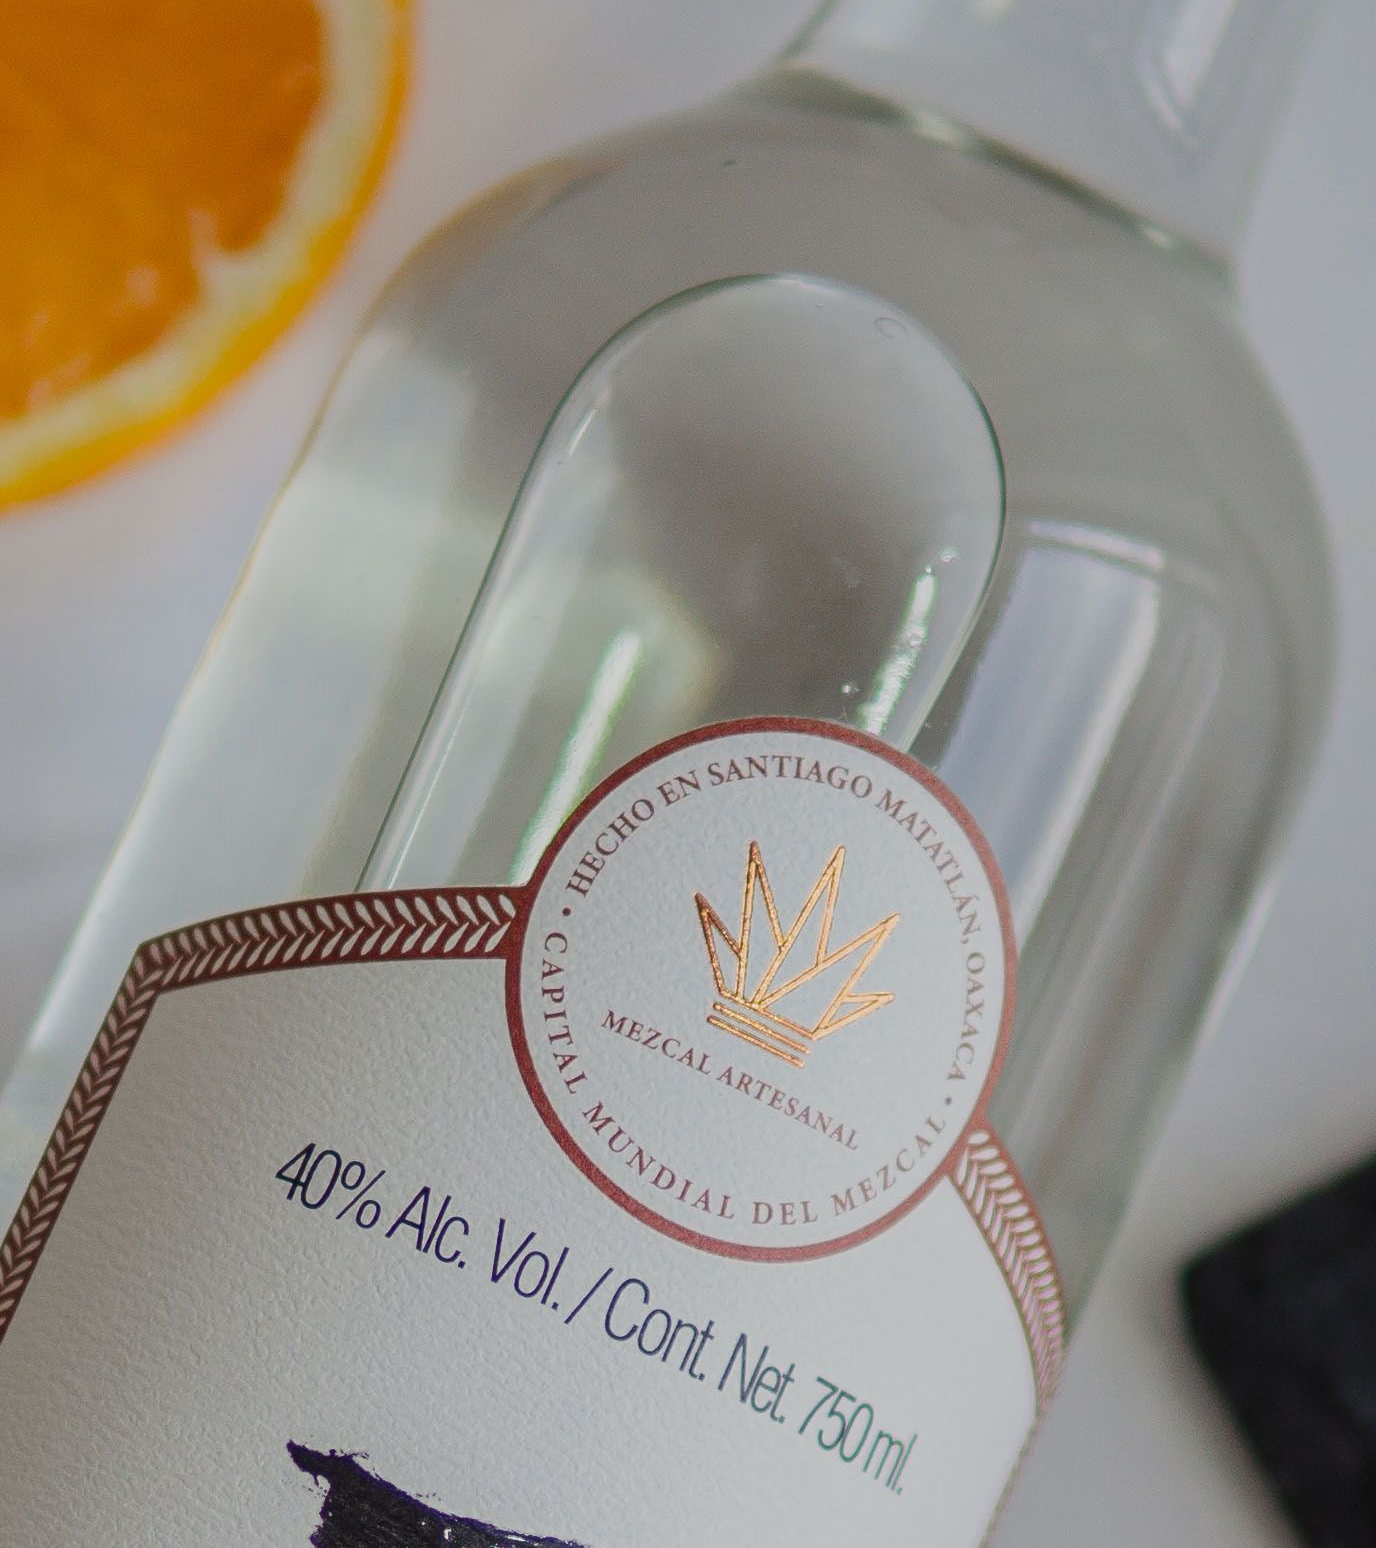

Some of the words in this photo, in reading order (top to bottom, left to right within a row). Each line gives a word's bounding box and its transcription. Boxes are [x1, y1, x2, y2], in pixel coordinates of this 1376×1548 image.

[566, 797, 655, 898] HECHO
[656, 769, 703, 807] EN
[707, 754, 874, 800] SANTIAGO
[875, 788, 981, 943] MATATLÁN,
[946, 952, 986, 1082] OAXACA
[540, 930, 589, 1095] CAPITAL
[582, 1100, 735, 1221] MUNDIAL
[752, 1199, 818, 1226] DEL
[831, 1115, 947, 1218] MEZCAL
[601, 1009, 712, 1076] MEZCAL
[716, 1064, 860, 1151] ARTESANAL
[275, 1142, 386, 1229] 40%
[385, 1186, 465, 1268] Alc.
[490, 1218, 569, 1312] Vol.
[604, 1277, 714, 1381] Cont.
[717, 1332, 795, 1425] Net.
